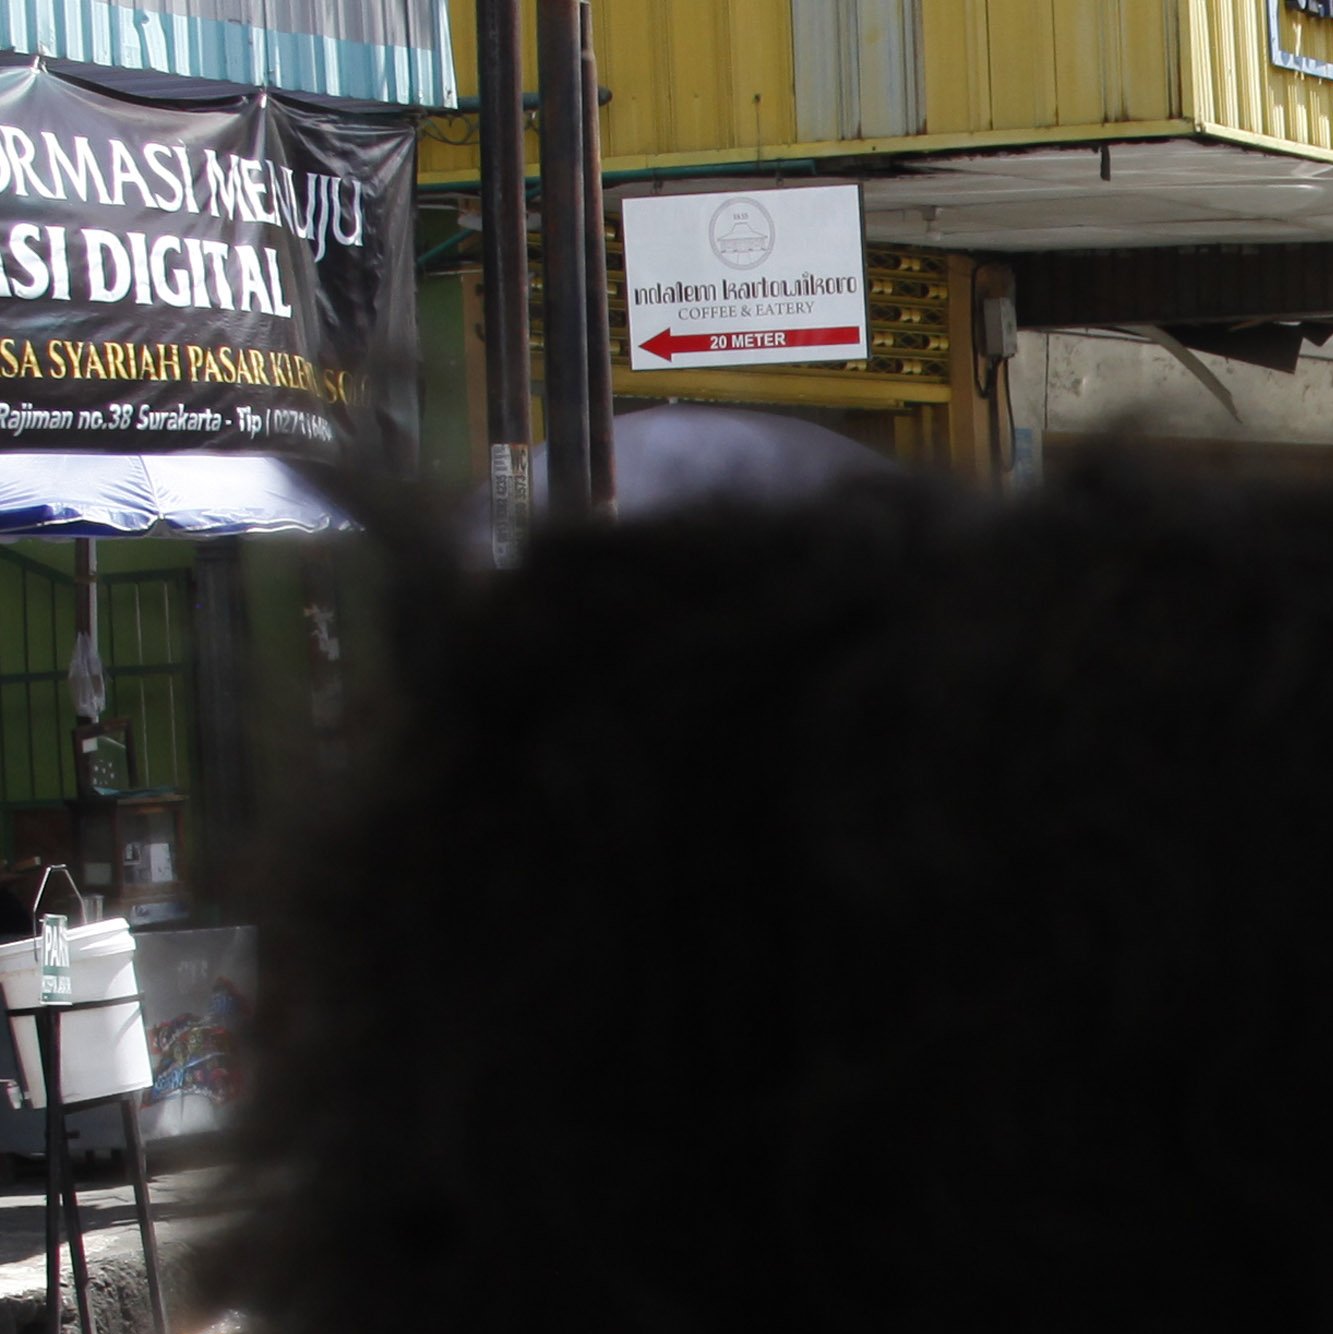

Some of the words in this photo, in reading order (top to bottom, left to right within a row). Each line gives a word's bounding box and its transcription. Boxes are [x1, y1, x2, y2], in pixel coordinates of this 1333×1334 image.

[203, 148, 363, 263] MENUJU
[81, 228, 292, 318] DIGITAL
[634, 280, 717, 305] ndalem
[678, 303, 736, 320] COFFEE
[740, 302, 751, 317] &
[756, 301, 815, 316] EATERY
[710, 335, 727, 350] 20
[731, 332, 786, 348] METER
[0, 339, 43, 379] SA
[49, 339, 182, 382] SYARIAH
[187, 345, 270, 386] PASAR
[78, 403, 133, 430] no.38
[136, 403, 222, 431] Surakarta
